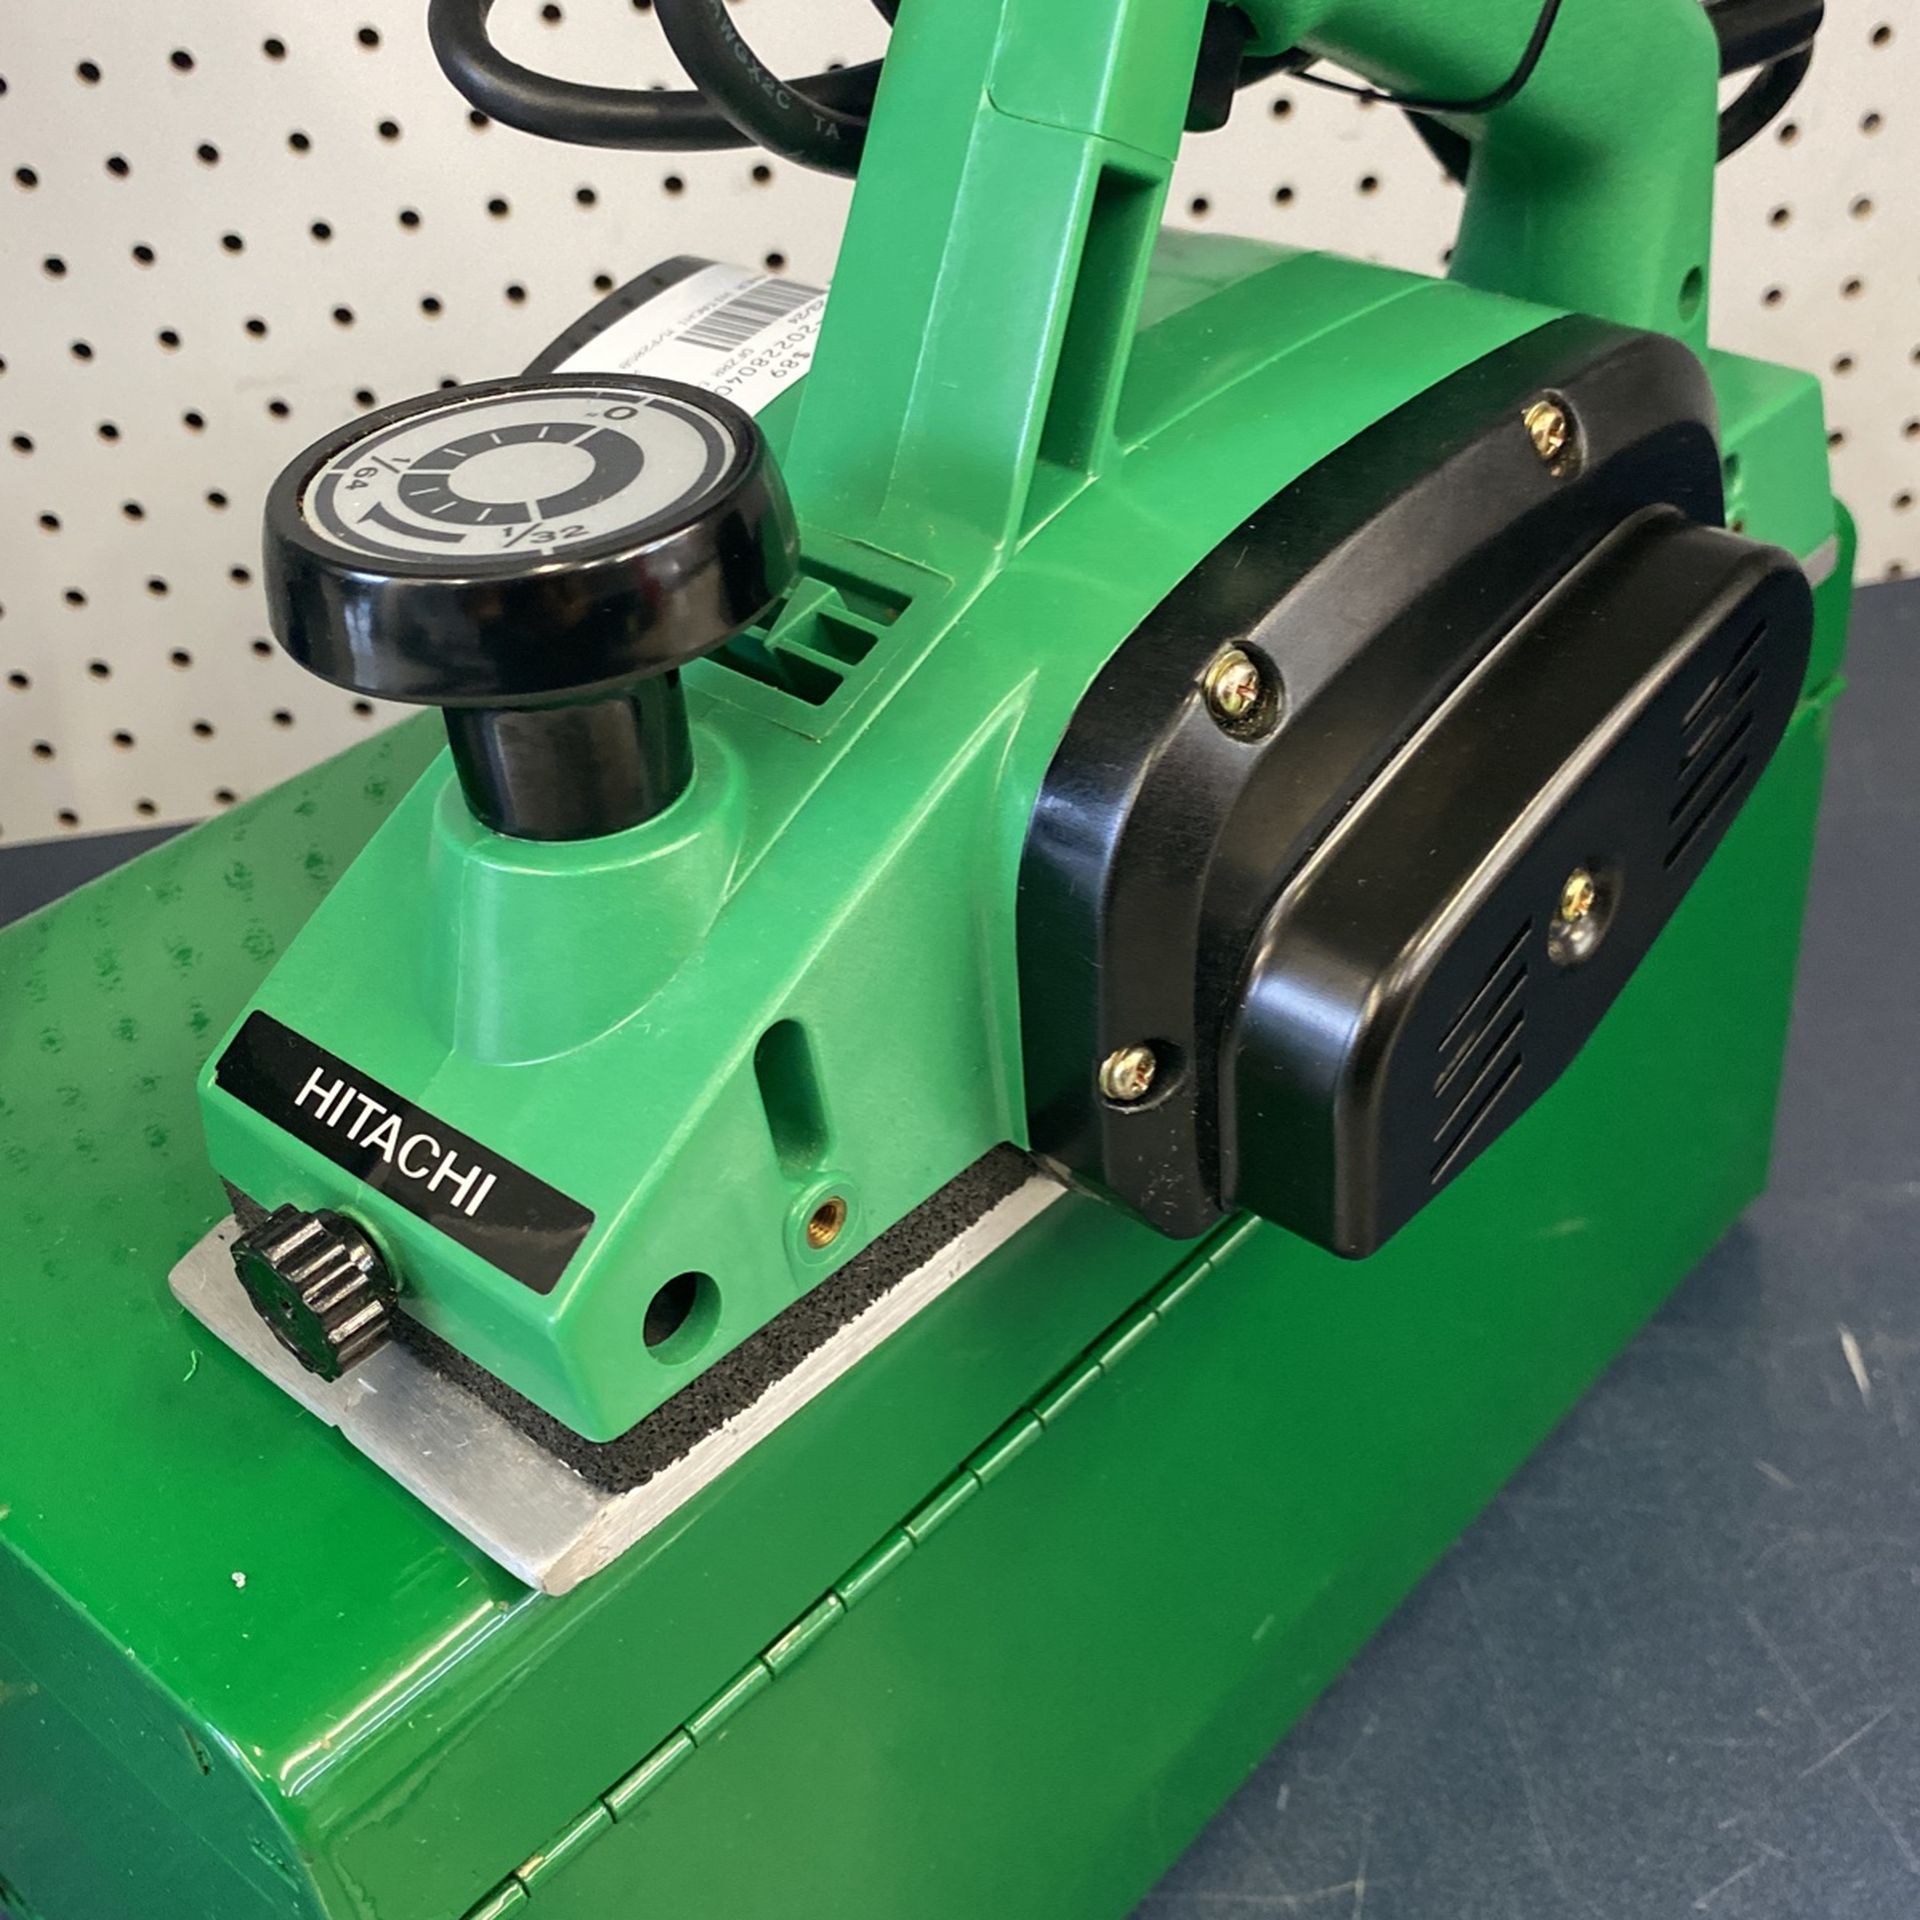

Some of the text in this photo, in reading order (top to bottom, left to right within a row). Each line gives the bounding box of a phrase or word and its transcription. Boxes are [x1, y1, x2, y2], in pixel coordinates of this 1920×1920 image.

[770, 350, 811, 379] $89
[344, 455, 411, 491] 1/64
[502, 522, 589, 548] 1/32
[294, 1066, 498, 1216] HITACHI
